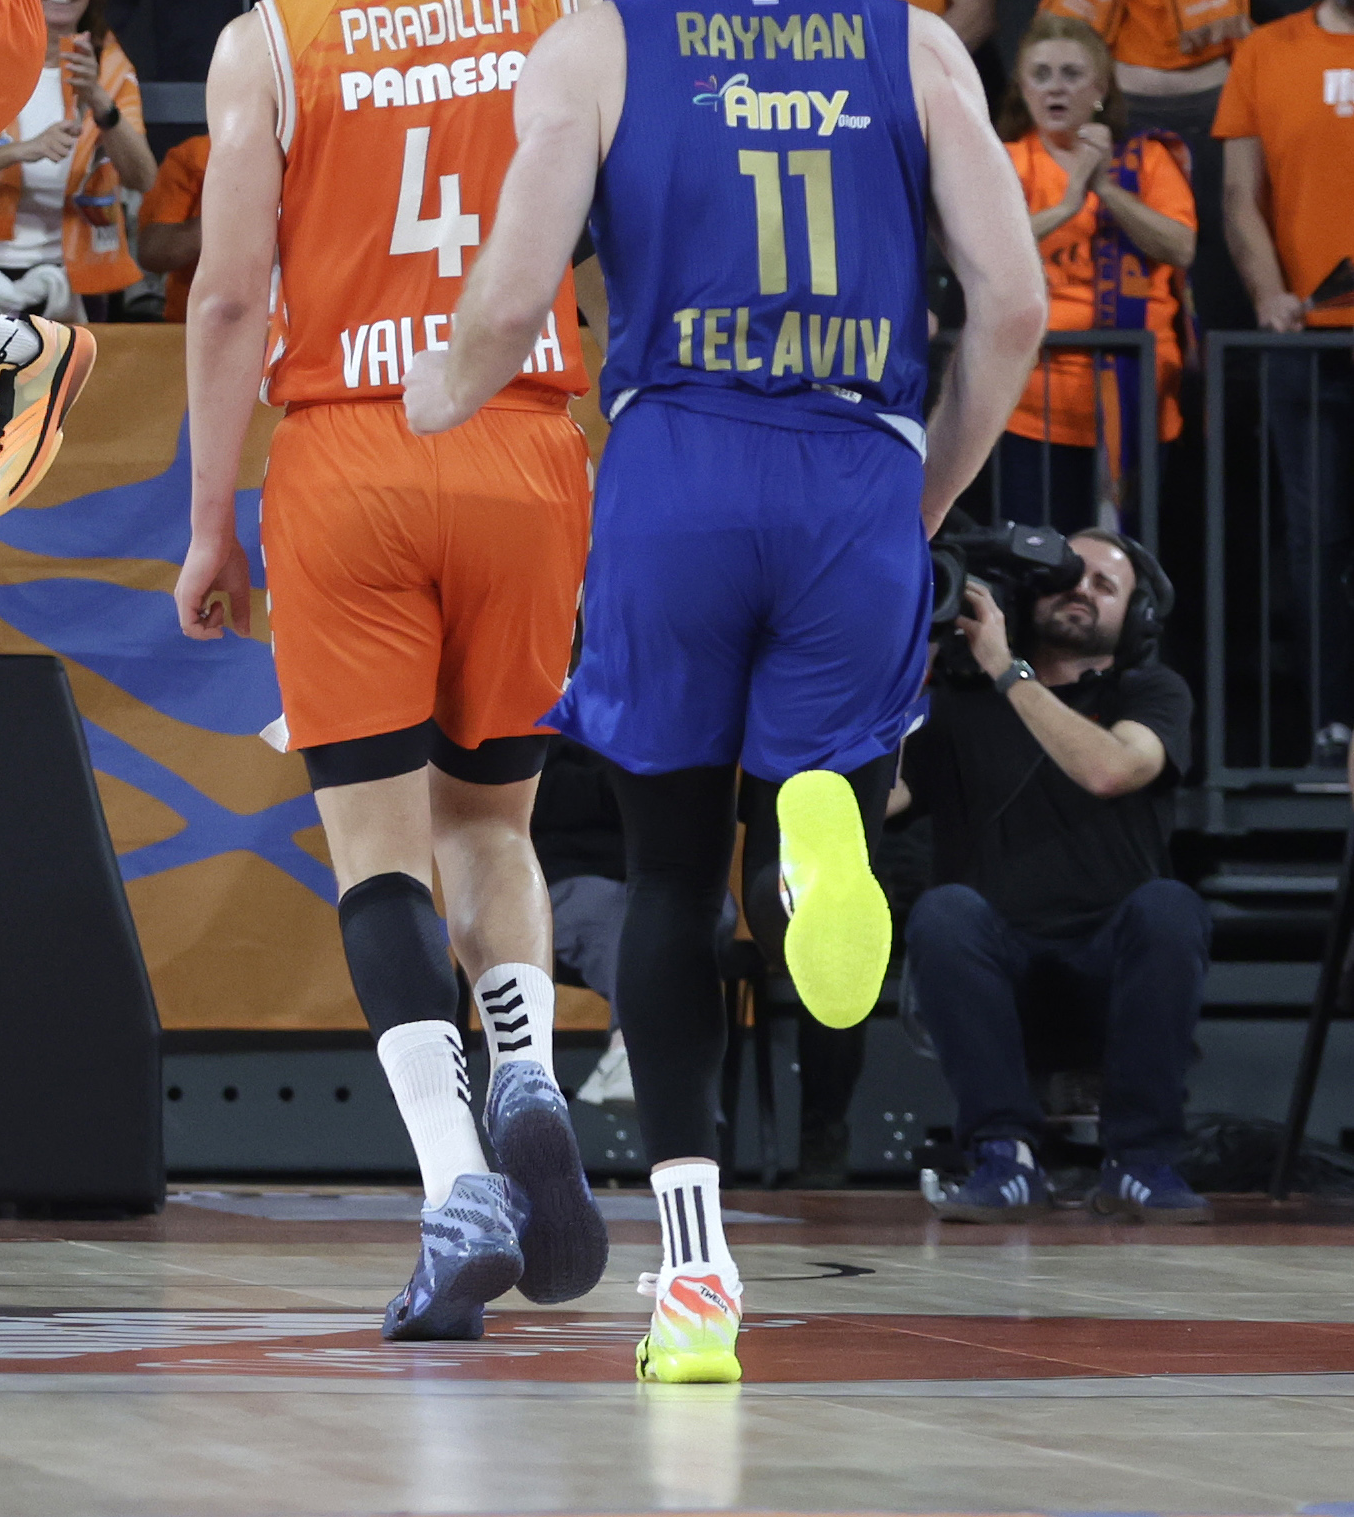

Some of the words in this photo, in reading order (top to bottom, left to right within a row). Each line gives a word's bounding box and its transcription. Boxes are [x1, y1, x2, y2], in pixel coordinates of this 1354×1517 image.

[676, 11, 866, 61] RAYMAN
[340, 50, 527, 111] PAMESA
[724, 86, 849, 136] Amy
[389, 126, 480, 278] 4
[738, 149, 838, 296] 11
[673, 307, 763, 372] TEL
[771, 310, 891, 383] AVIV
